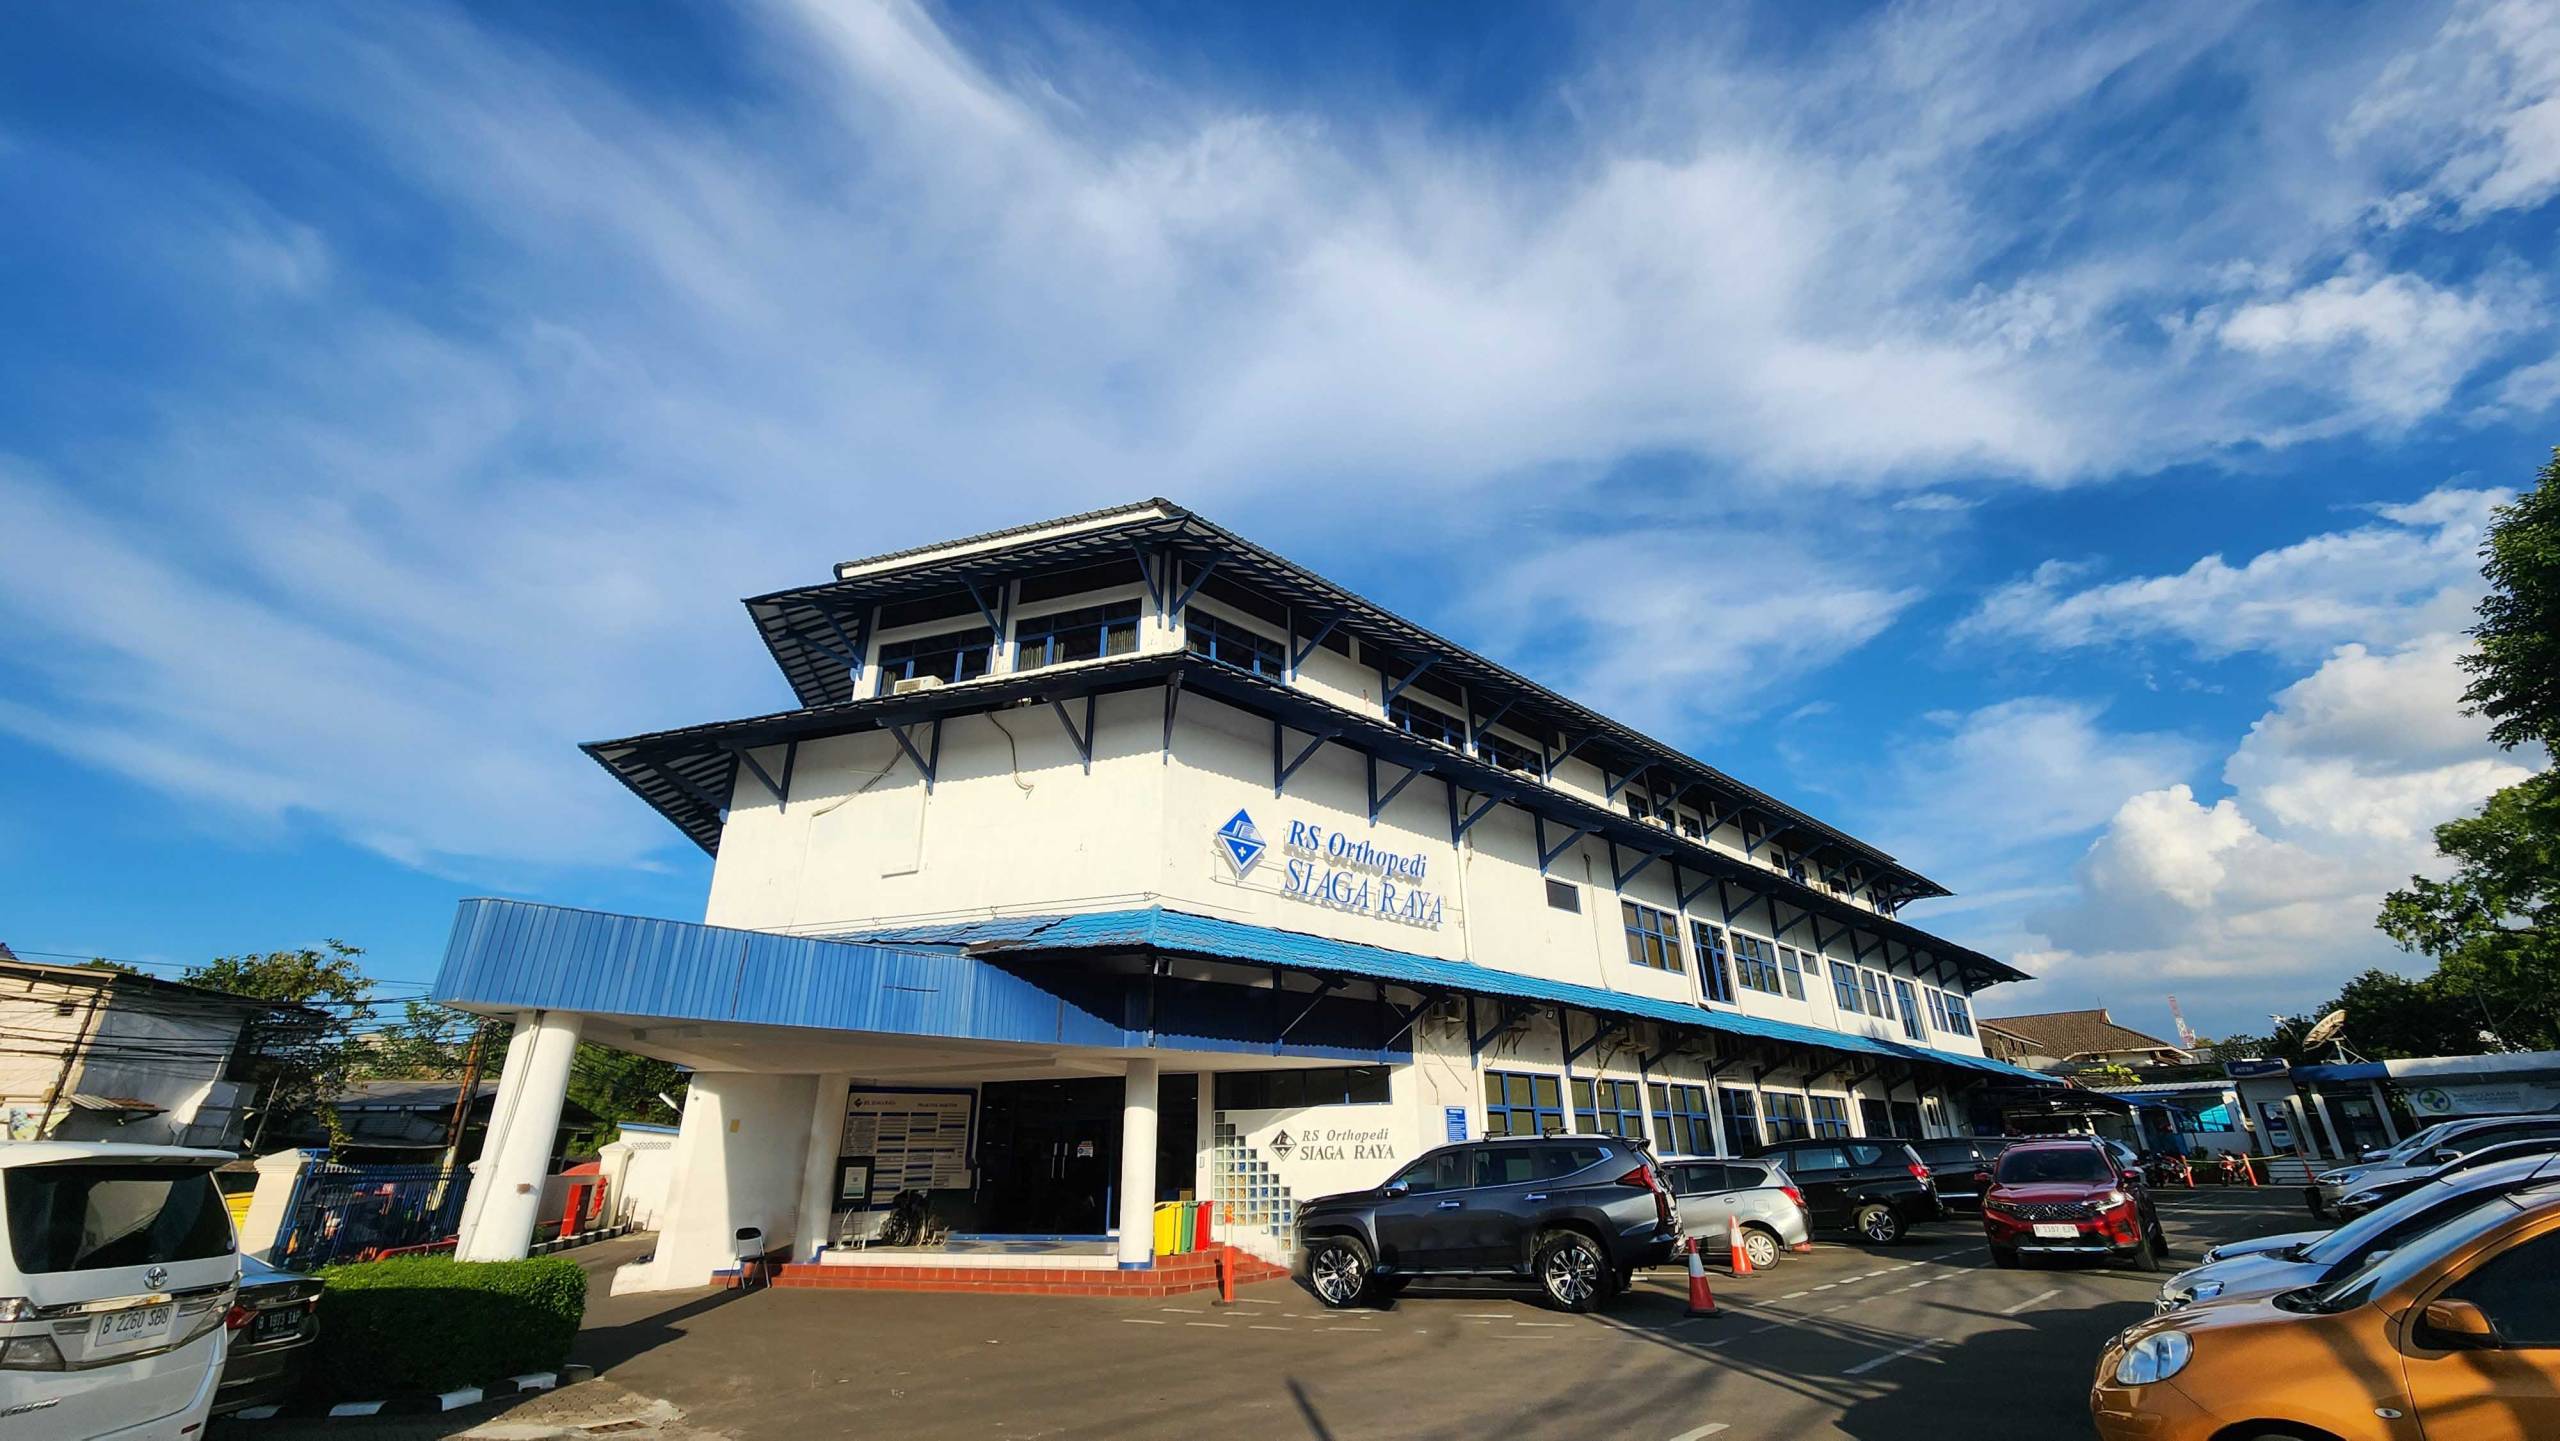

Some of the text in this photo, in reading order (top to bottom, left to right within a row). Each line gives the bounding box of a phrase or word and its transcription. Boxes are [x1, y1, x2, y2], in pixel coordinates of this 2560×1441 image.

[1289, 820, 1427, 878] RS Orthopedi
[1284, 858, 1443, 923] SIAGA RAYA
[1302, 1128, 1389, 1143] RS Orthopedi
[1300, 1144, 1395, 1161] SIAGA RAYA
[103, 1316, 112, 1335] B
[116, 1311, 146, 1332] 2260
